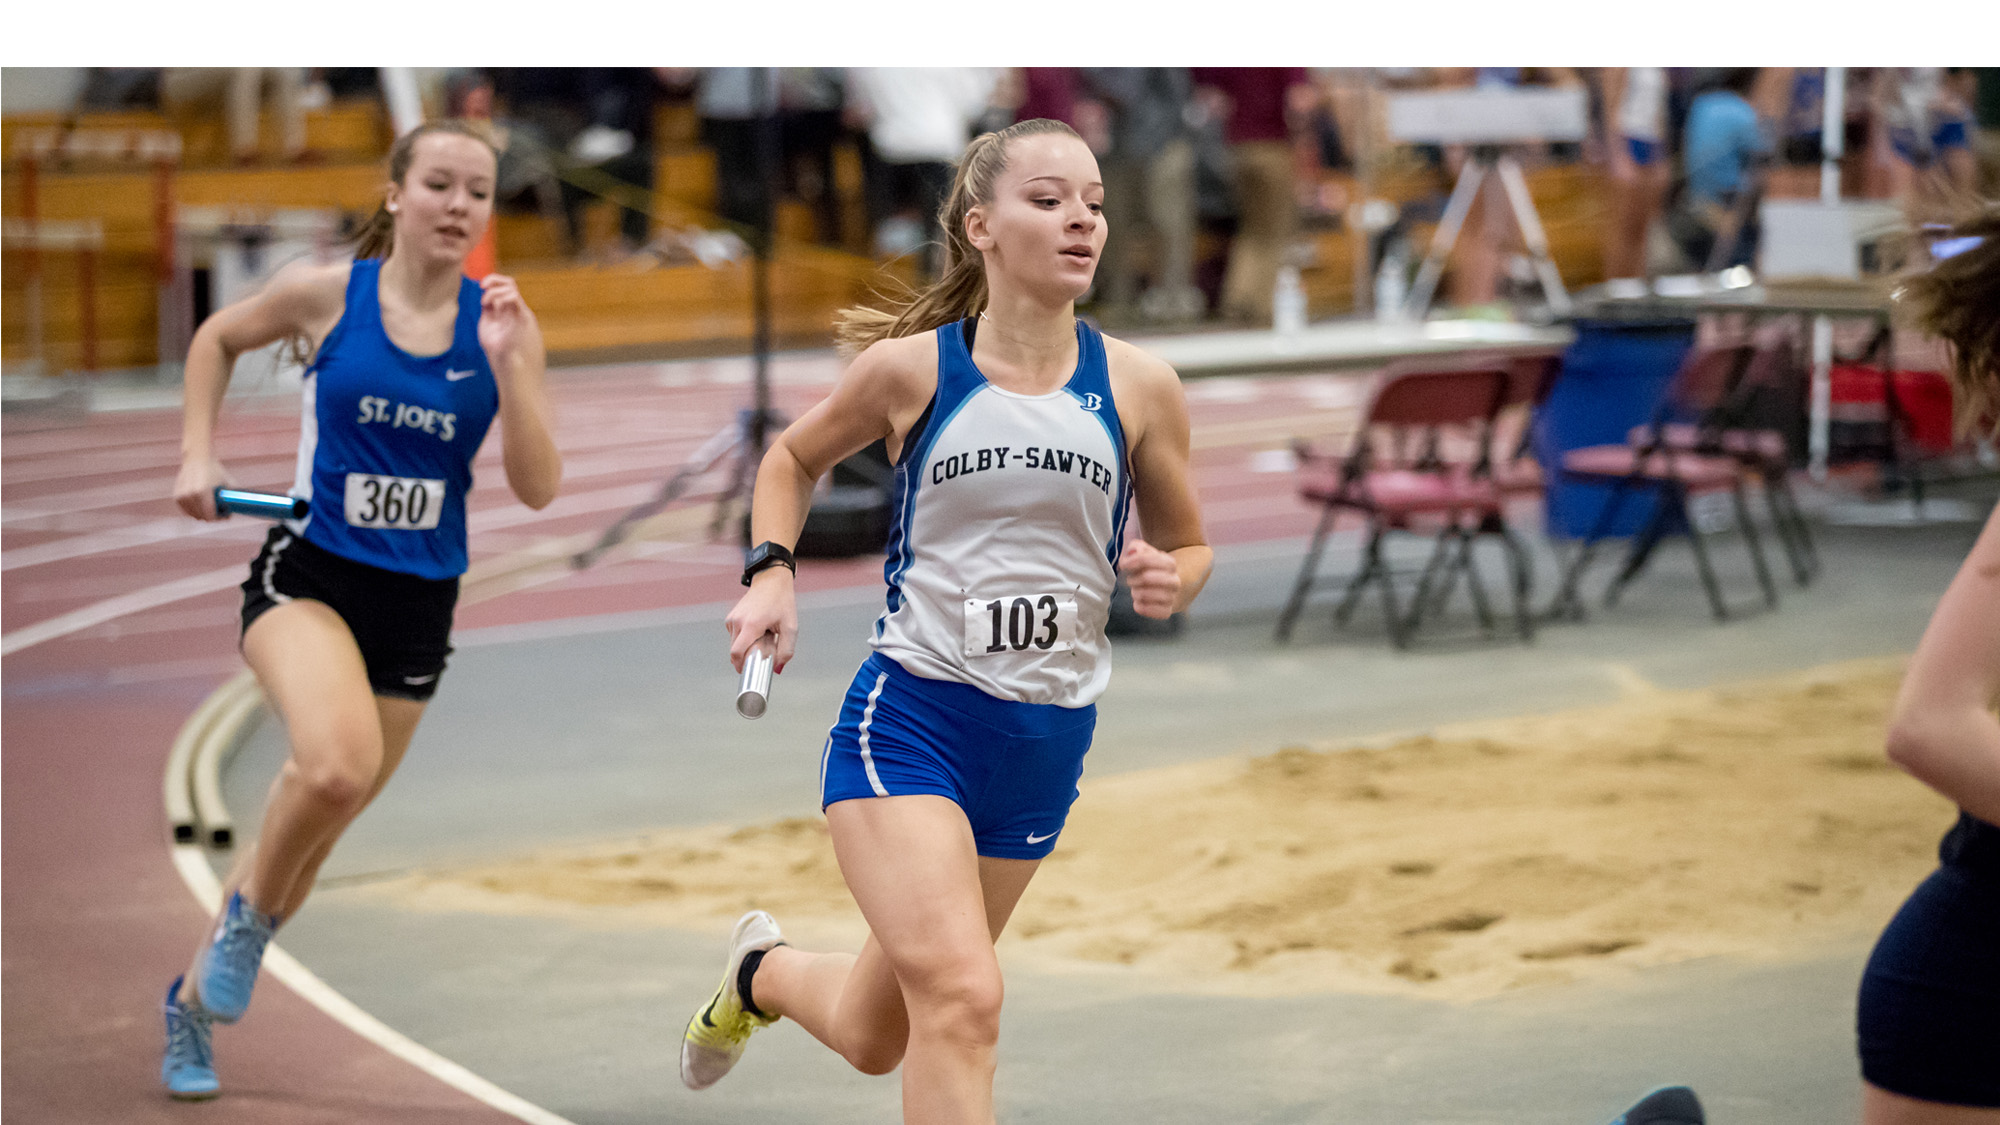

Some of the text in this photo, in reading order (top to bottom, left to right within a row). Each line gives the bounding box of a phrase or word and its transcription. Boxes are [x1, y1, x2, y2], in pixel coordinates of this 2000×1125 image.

[357, 395, 457, 442] ST. JOE'S
[932, 447, 1112, 496] COLBY-SAWYER
[359, 479, 428, 525] 360
[986, 595, 1059, 653] 103
